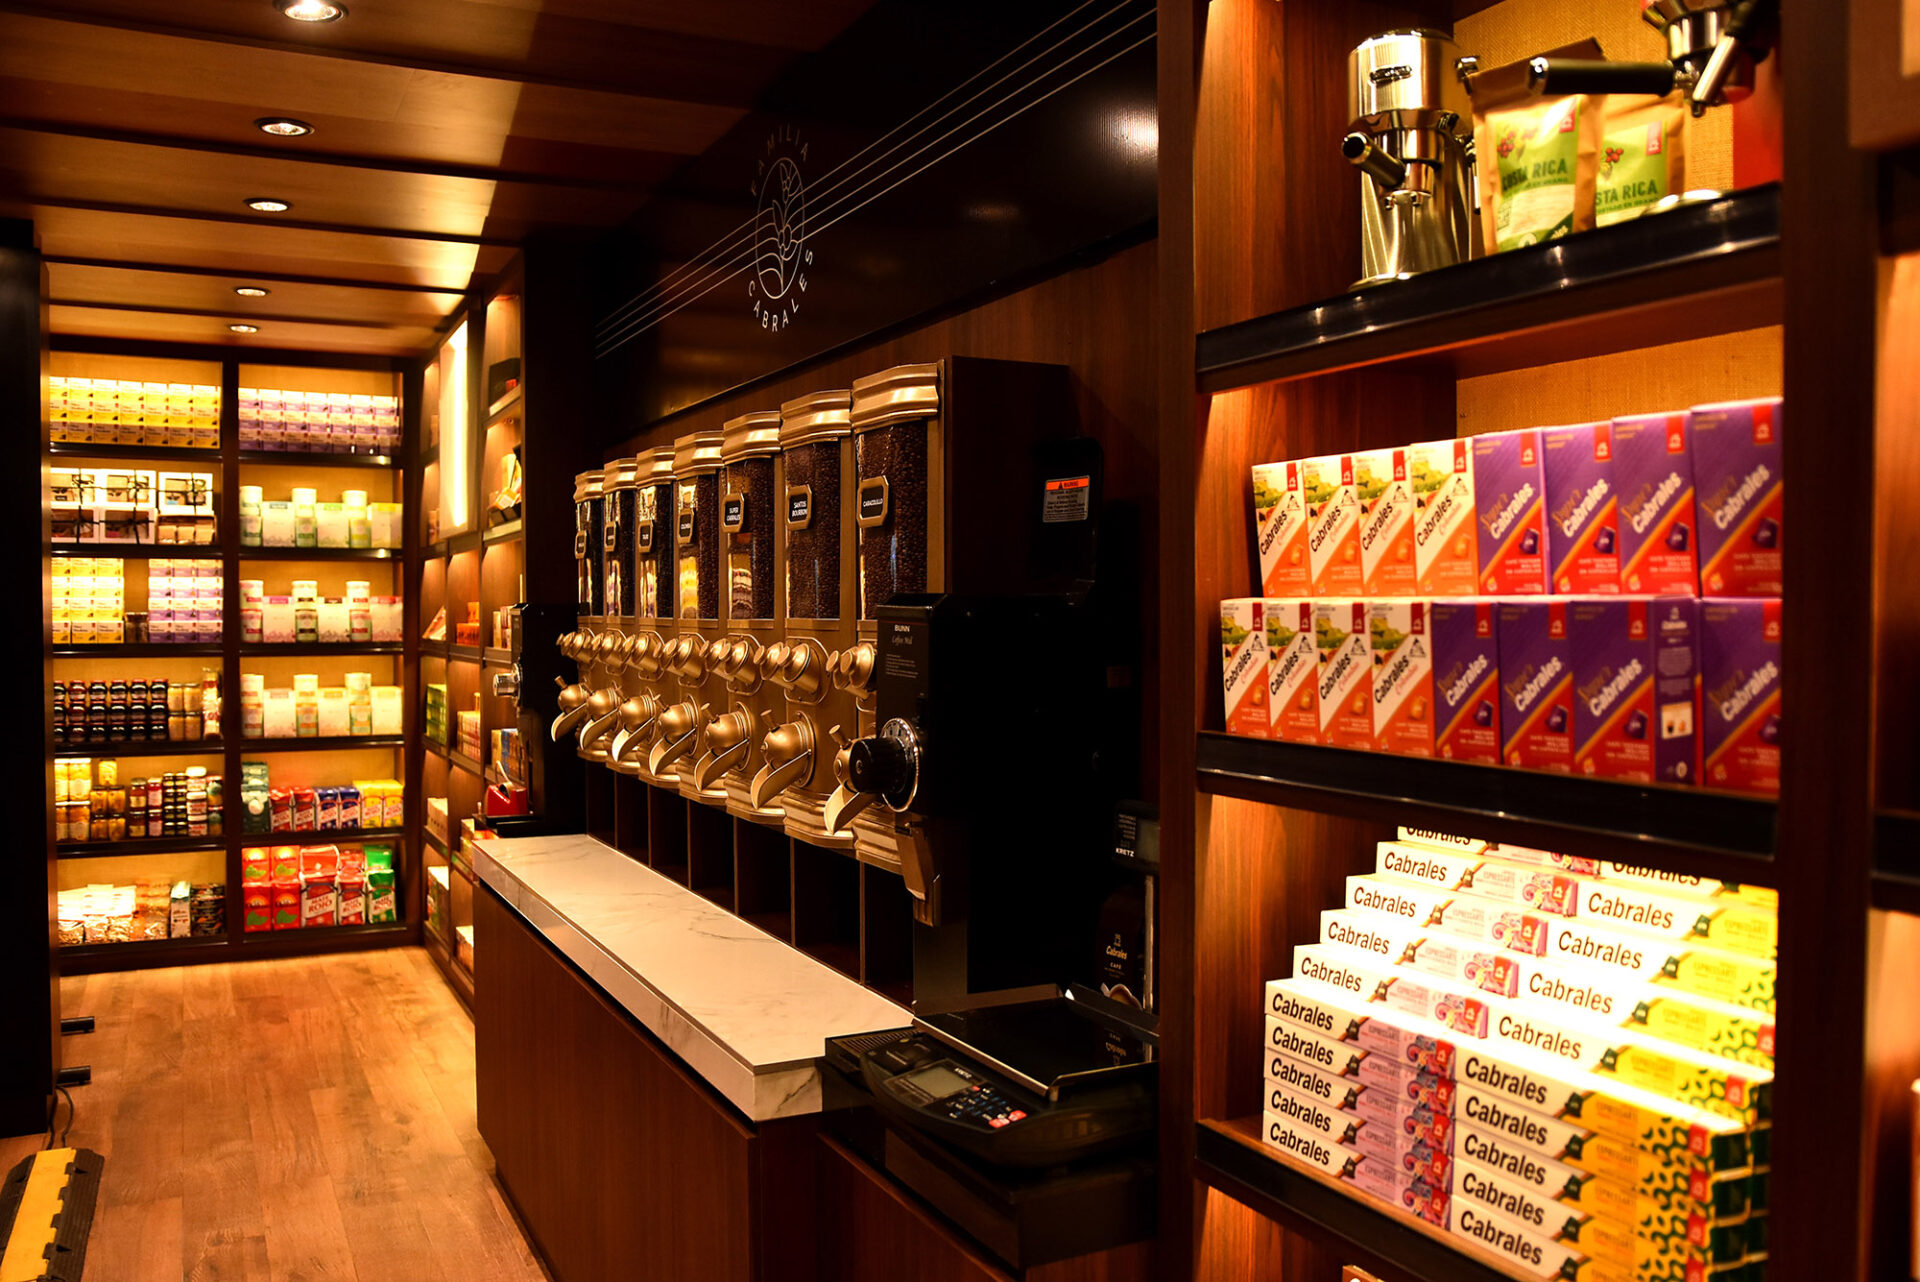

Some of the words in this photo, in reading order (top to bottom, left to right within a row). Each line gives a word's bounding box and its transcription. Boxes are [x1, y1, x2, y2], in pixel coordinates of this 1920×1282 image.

[750, 122, 809, 197] FAMILIA
[1532, 158, 1568, 178] RICA
[1596, 190, 1618, 206] STA
[1622, 179, 1657, 199] RICA
[748, 248, 814, 333] CABRALES
[1490, 482, 1535, 540] Cabrales
[1561, 478, 1609, 538] Cabrales
[1631, 472, 1682, 534] Cabrales
[1713, 464, 1770, 530] Cabrales
[1259, 509, 1288, 556] Cabrales
[1310, 505, 1342, 552] Cabrales
[1361, 501, 1394, 551] Cabrales
[1416, 494, 1453, 547] Cabrales
[894, 624, 911, 633] BUNN
[1224, 648, 1253, 692] Cabrales
[1269, 650, 1300, 696] Cabrales
[1319, 652, 1352, 700] Cabrales
[1374, 654, 1410, 704] Cabrales
[1446, 653, 1488, 707] Cabrales
[1514, 655, 1562, 712] Cabrales
[1588, 657, 1643, 717] Cabrales
[1721, 660, 1779, 721] Cabrales
[1115, 847, 1135, 858] KRETZ
[1384, 851, 1447, 883] Cabrales
[308, 900, 333, 913] ROJO
[1353, 886, 1416, 918] Cabrales
[1588, 892, 1674, 930] Cabrales
[1105, 945, 1128, 960] Cabrales
[1328, 920, 1390, 956] Cabrales
[1558, 930, 1643, 970] Cabrales
[1300, 956, 1363, 993] Cabrales
[1529, 972, 1613, 1014] Cabrales
[1272, 993, 1334, 1031] Cabrales
[1272, 1026, 1335, 1066] Cabrales
[1498, 1015, 1582, 1061] Cabrales
[1271, 1057, 1332, 1099] Cabrales
[1465, 1056, 1548, 1105] Cabrales
[1271, 1090, 1332, 1133] Cabrales
[1465, 1095, 1548, 1146] Cabrales
[1270, 1122, 1331, 1166] Cabrales
[1464, 1133, 1547, 1186] Cabrales
[1462, 1172, 1545, 1227] Cabrales
[1460, 1210, 1544, 1266] Cabrales
